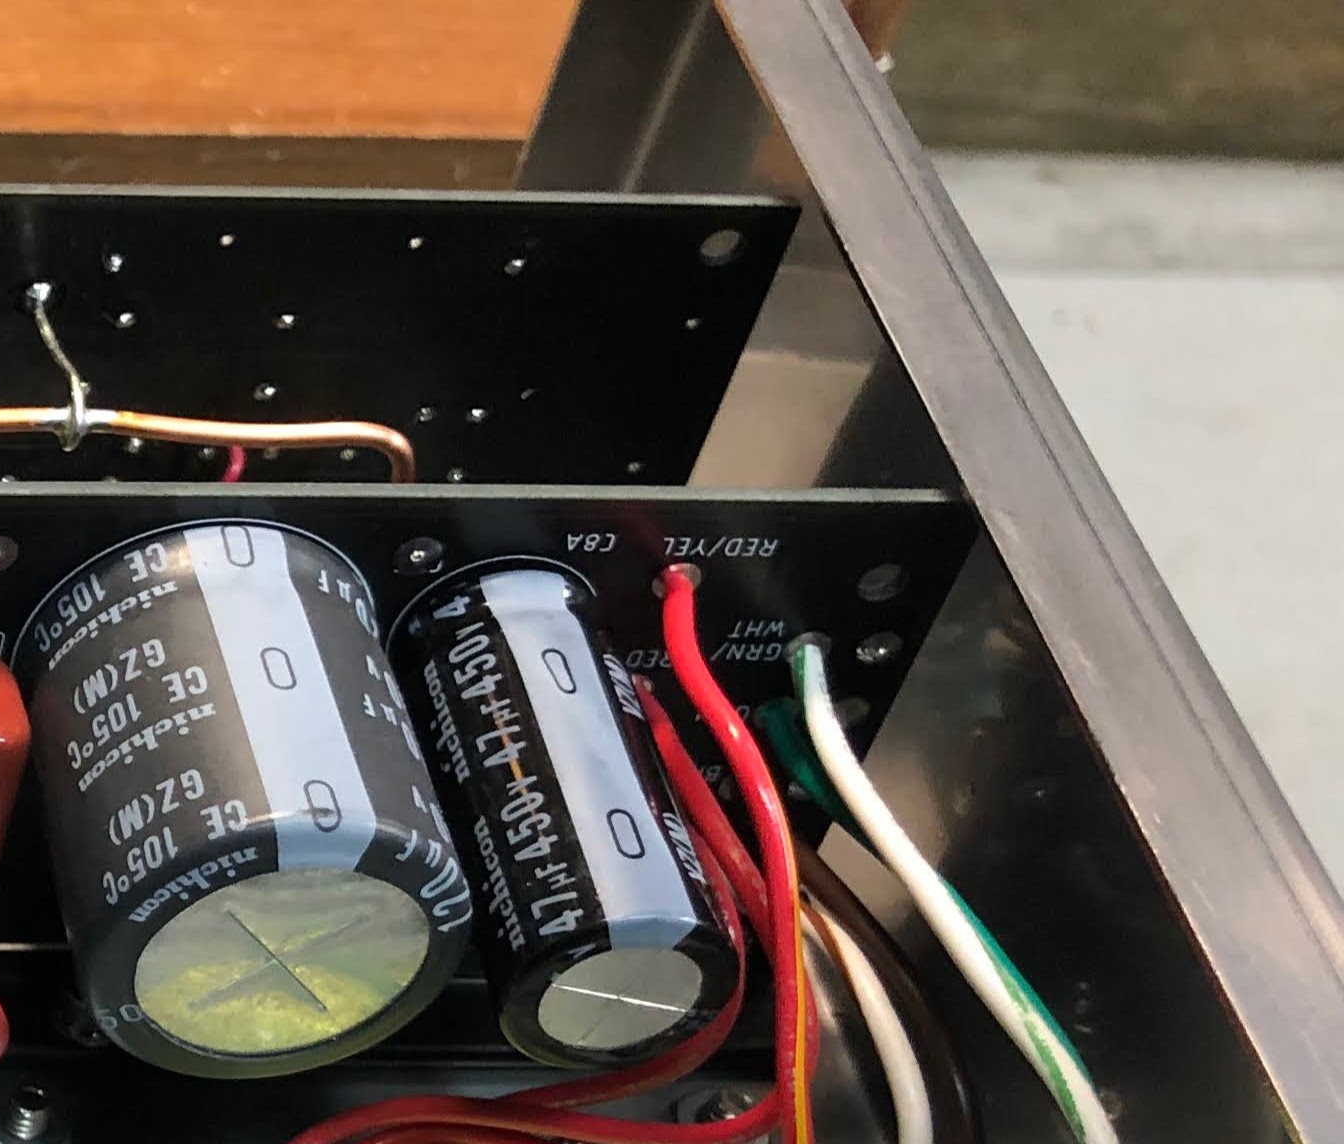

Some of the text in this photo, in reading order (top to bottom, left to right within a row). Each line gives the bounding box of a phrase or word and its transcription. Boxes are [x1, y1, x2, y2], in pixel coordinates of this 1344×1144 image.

[123, 542, 169, 582] CE
[567, 533, 615, 552] C8A
[663, 536, 778, 557] RED/YEL
[47, 581, 178, 671] nichicon
[711, 642, 782, 661] GRN/
[727, 620, 785, 638] WHT
[72, 638, 164, 713] GZ(M)
[164, 663, 210, 703] CE
[77, 703, 216, 792] nichicon
[423, 660, 470, 785] nichicon
[108, 769, 205, 846] GZ(M)
[200, 798, 249, 840] CE
[127, 846, 258, 924] nichicon
[474, 815, 526, 951] nichicon
